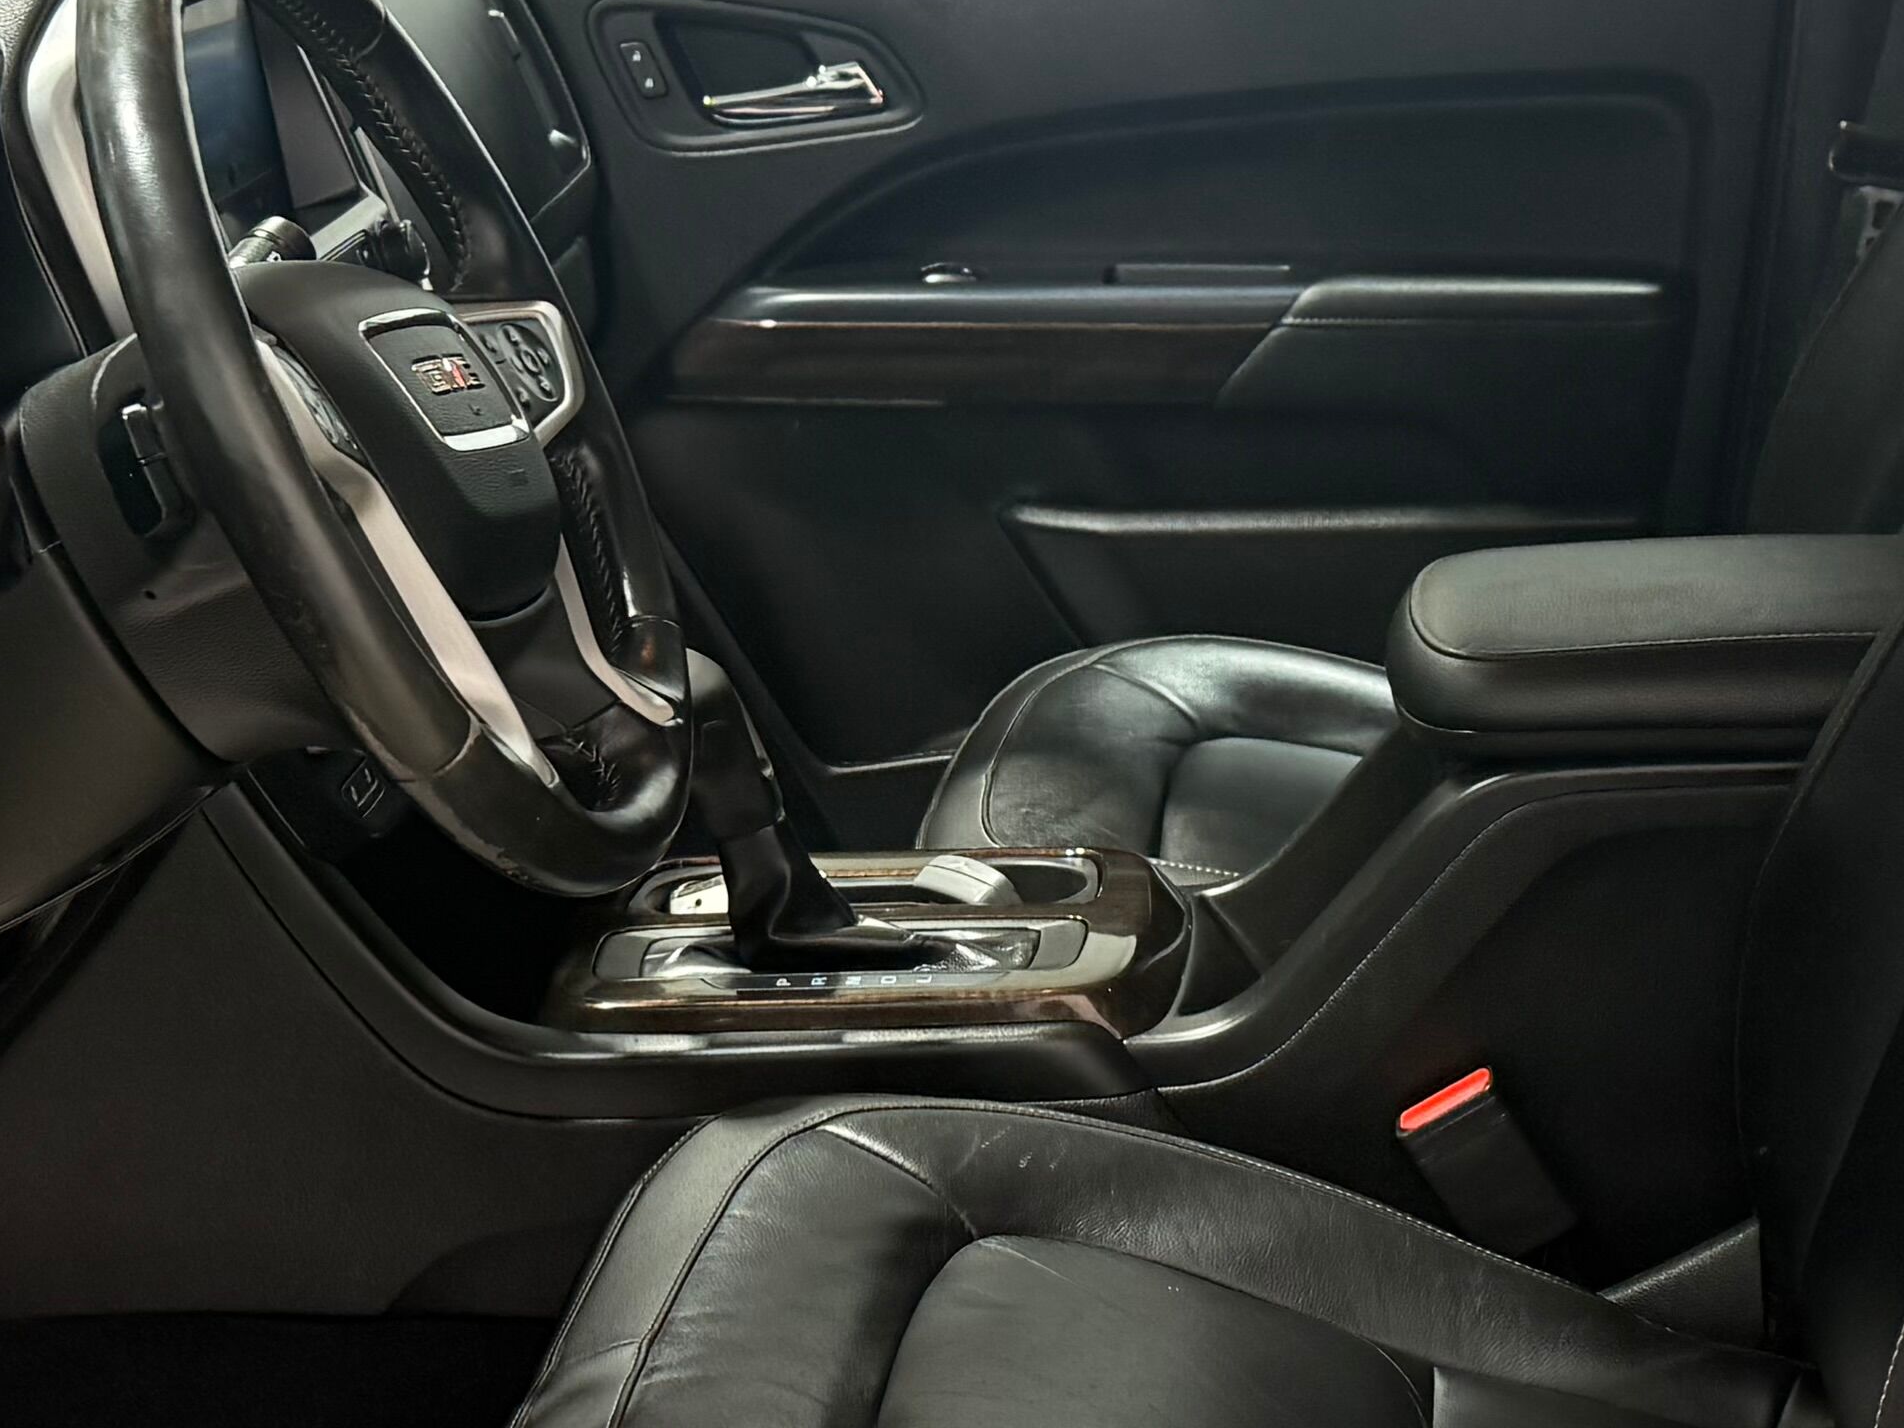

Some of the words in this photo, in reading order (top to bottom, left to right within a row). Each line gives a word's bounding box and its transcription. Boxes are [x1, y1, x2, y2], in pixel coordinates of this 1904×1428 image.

[776, 977, 791, 987] P
[810, 976, 828, 986] R
[845, 976, 862, 986] N
[880, 975, 897, 984] D
